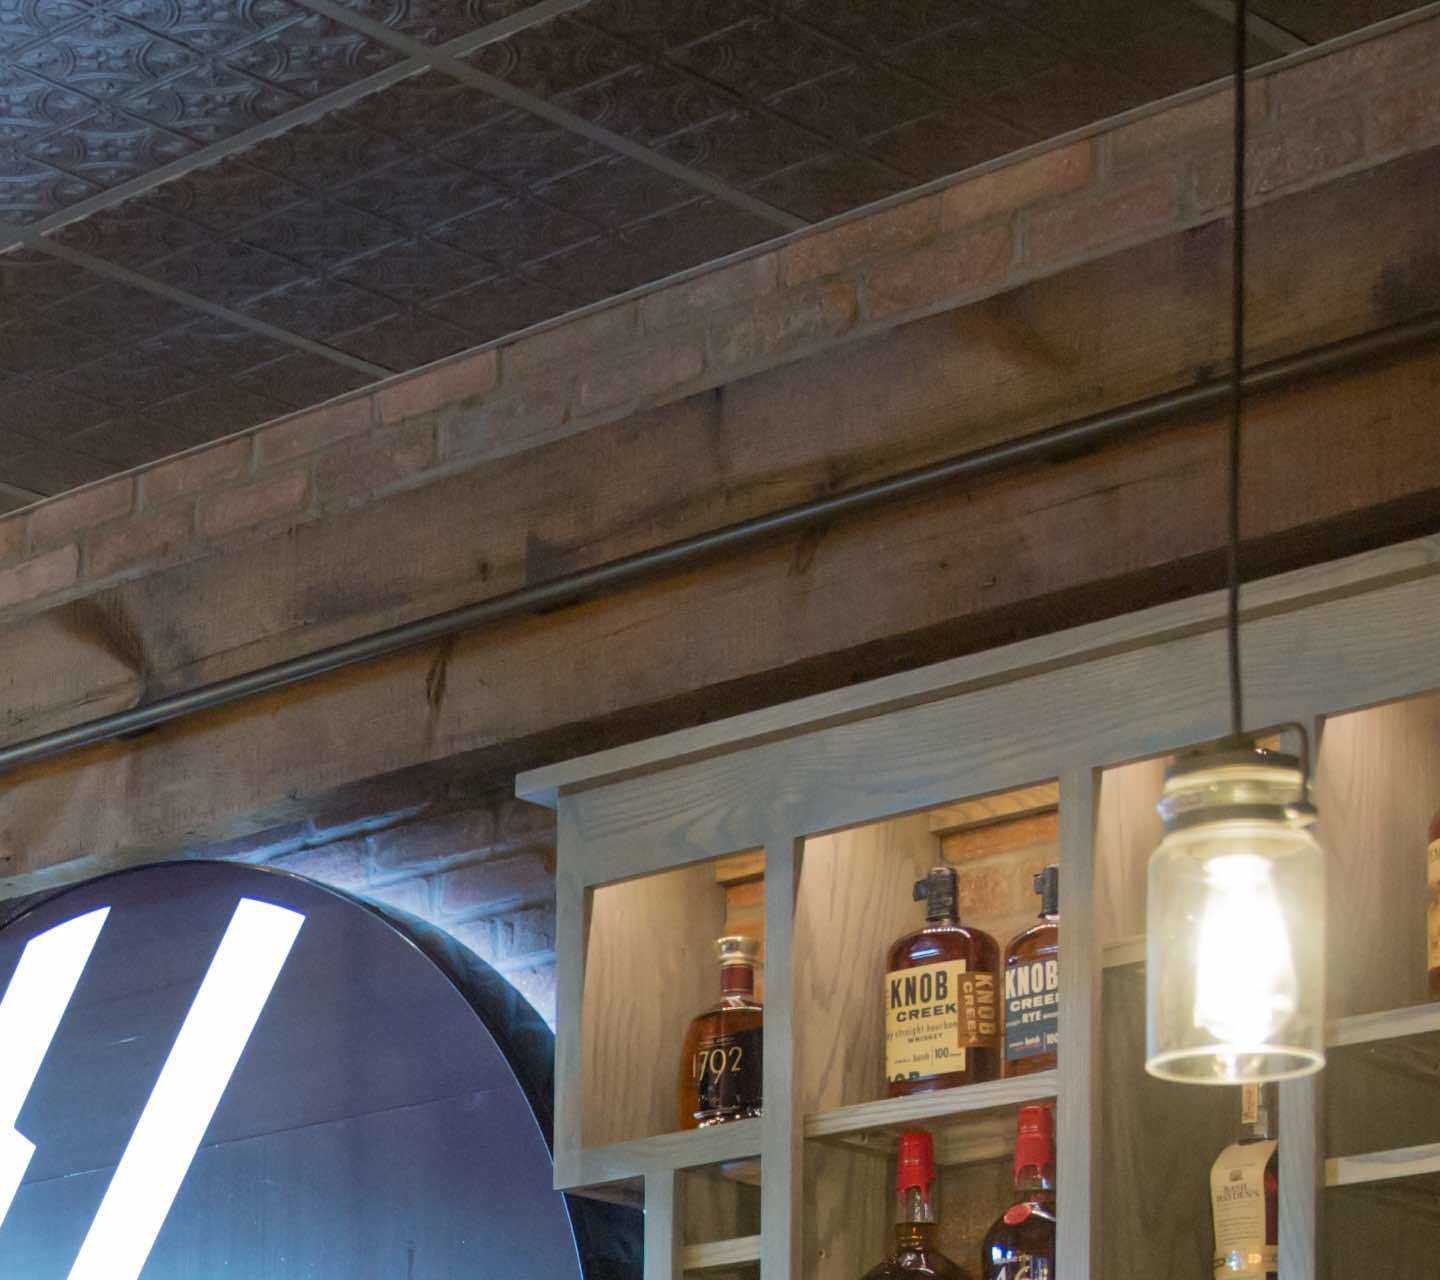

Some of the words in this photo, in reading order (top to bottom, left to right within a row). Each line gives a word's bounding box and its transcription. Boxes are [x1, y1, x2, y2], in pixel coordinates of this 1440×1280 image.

[891, 970, 948, 1009] KNOB
[1005, 960, 1058, 1000] KNOB
[896, 1002, 957, 1022] CREEK
[962, 981, 978, 1043] CREEK
[975, 974, 996, 1035] KNOB
[1022, 1010, 1042, 1023] RYE
[693, 1046, 742, 1084] 1792
[935, 1048, 949, 1059] 100
